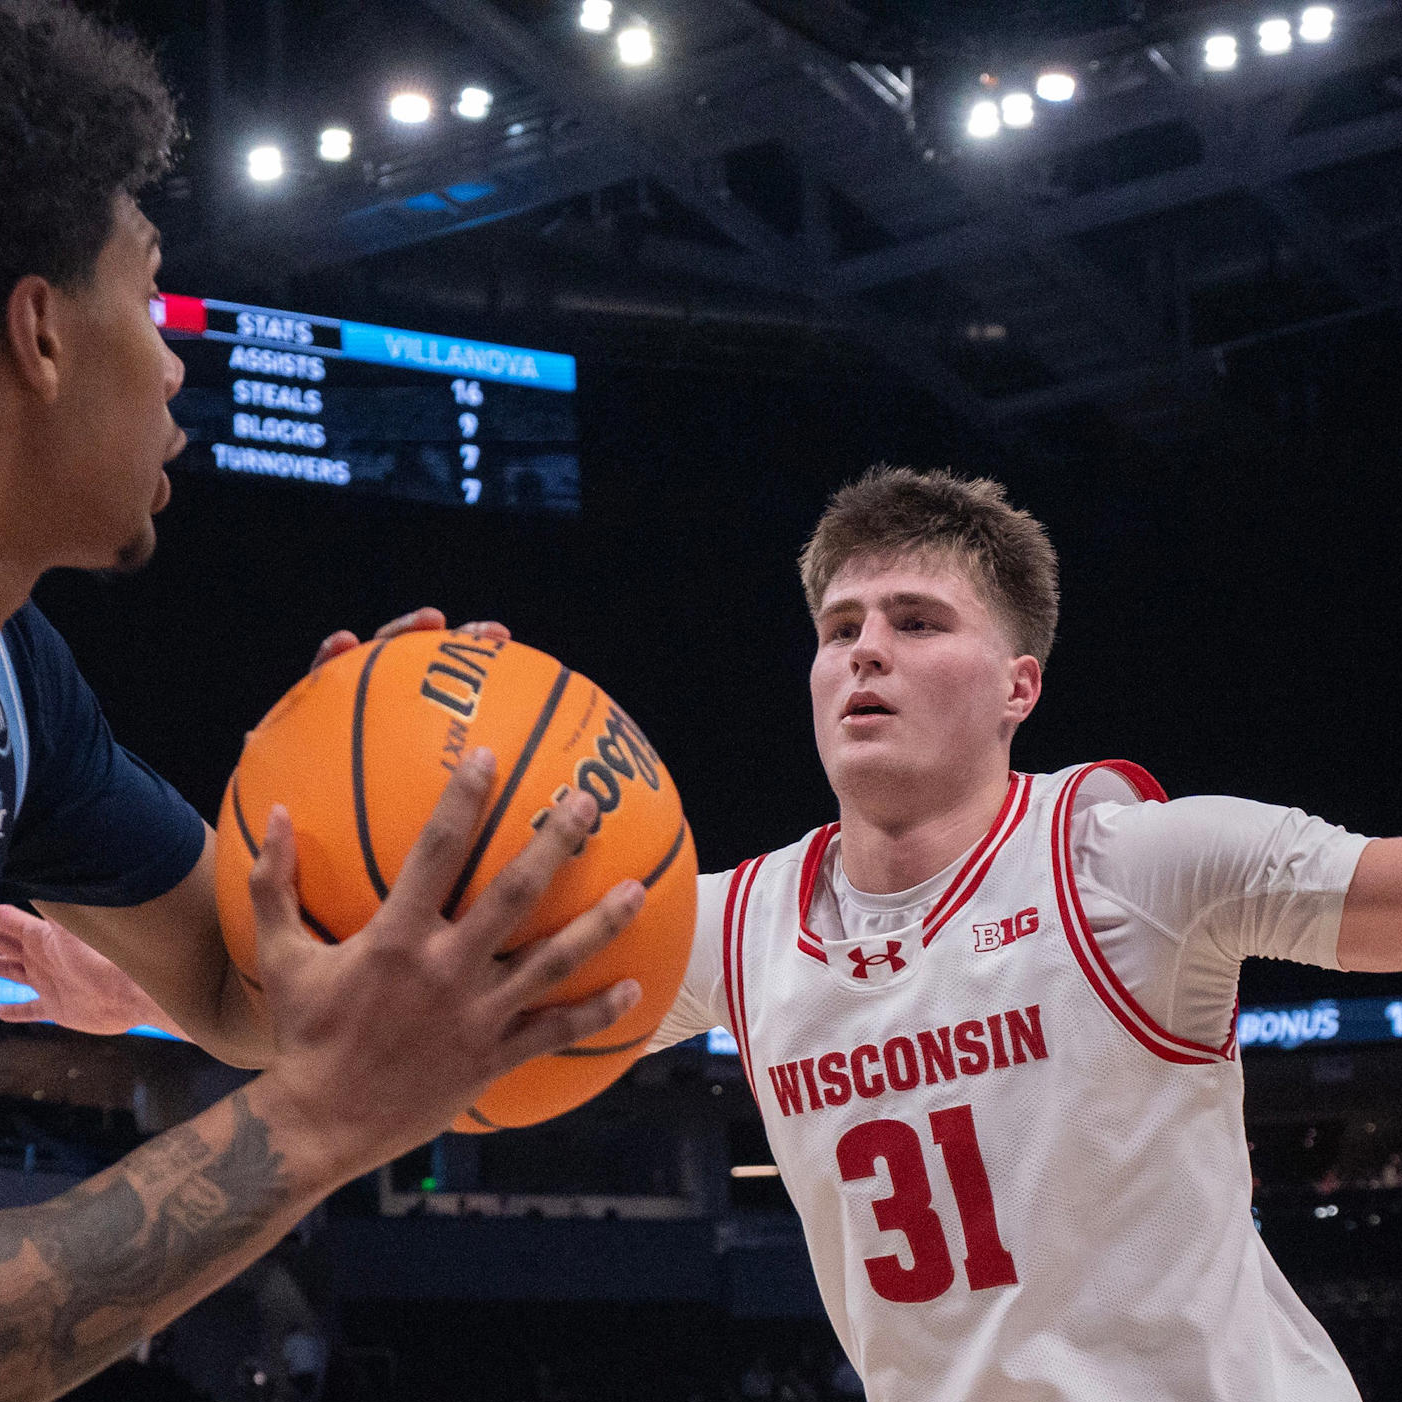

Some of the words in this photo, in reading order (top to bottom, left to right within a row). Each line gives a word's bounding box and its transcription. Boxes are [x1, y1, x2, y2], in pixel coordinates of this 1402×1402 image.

[228, 344, 327, 383] ASSISTS
[236, 310, 315, 347] STATS
[382, 332, 541, 381] VILLANOVA
[232, 378, 324, 415] STEALS
[457, 411, 479, 440] 9
[232, 411, 327, 449] BLOCKS
[211, 442, 352, 487] TURNOVERS
[460, 477, 484, 505] 7
[768, 1003, 1050, 1118] WISCONSIN
[834, 1103, 1019, 1304] 31
